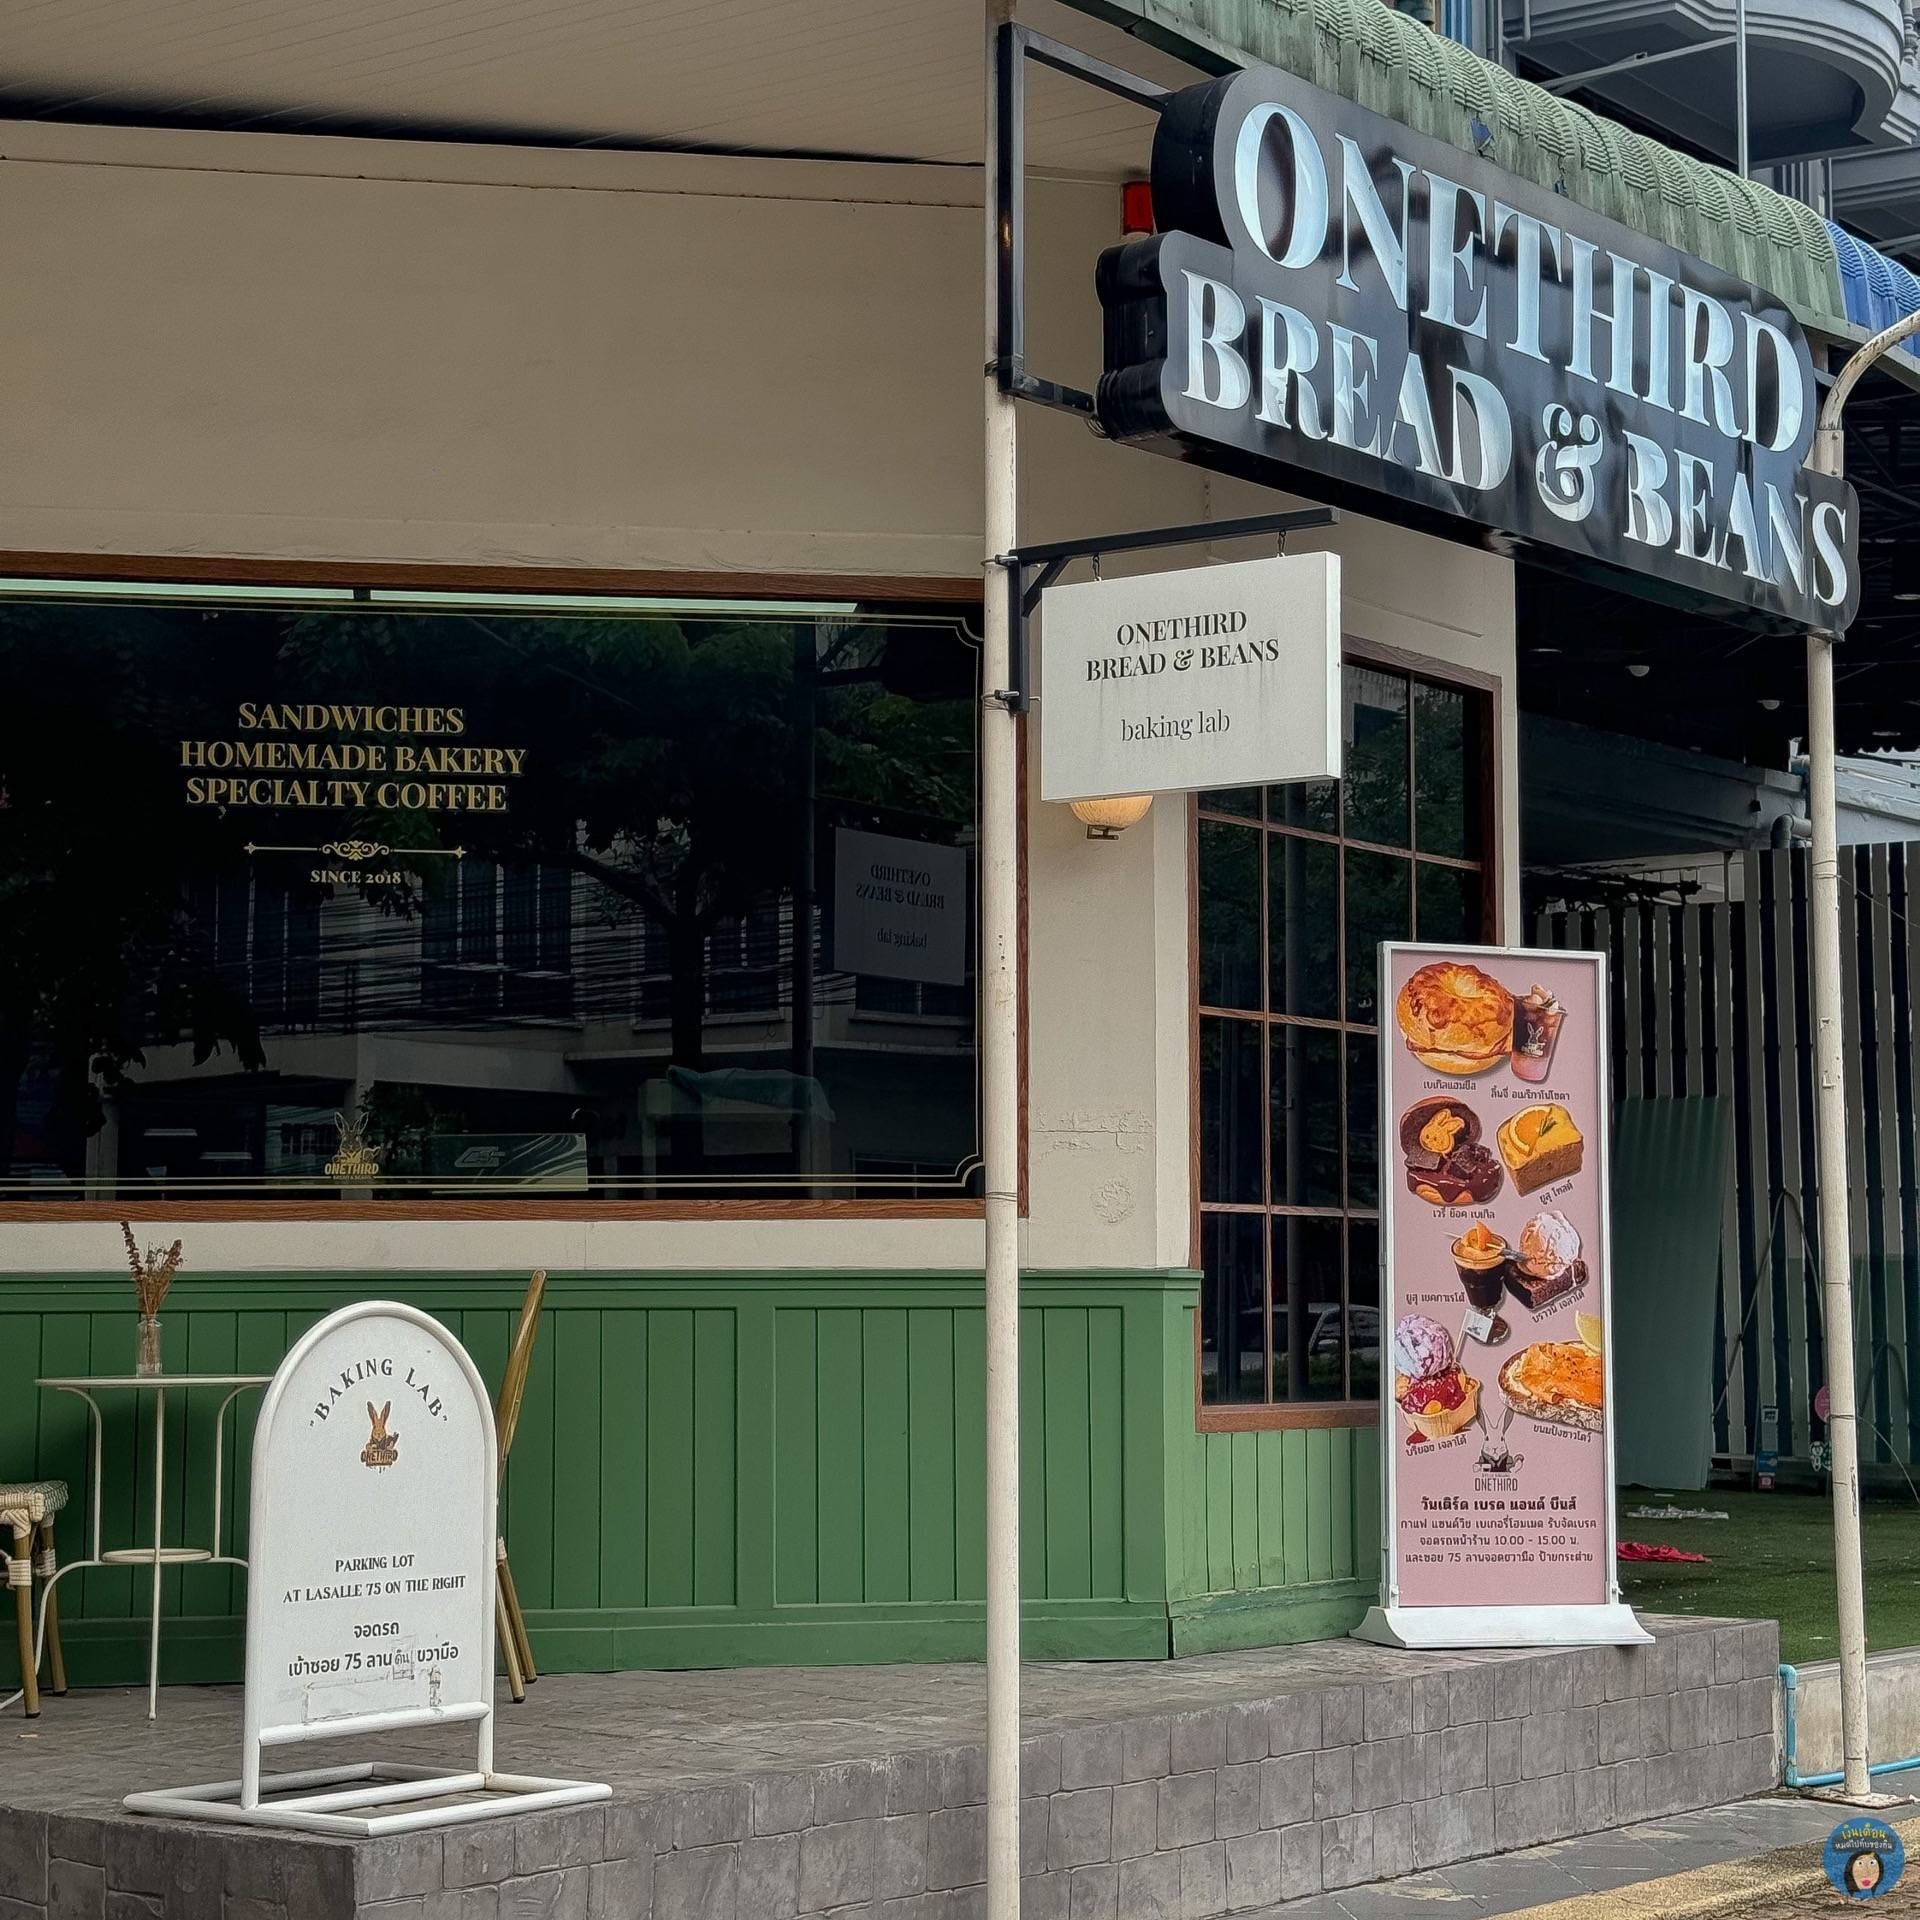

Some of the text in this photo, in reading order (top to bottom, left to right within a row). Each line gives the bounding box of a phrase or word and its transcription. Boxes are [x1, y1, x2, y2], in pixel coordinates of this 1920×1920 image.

[1234, 101, 1804, 452] ONETHIRD
[1180, 268, 1848, 606] BREAD & BEANS
[1116, 610, 1248, 646] ONETHIRD
[1086, 638, 1279, 681] BREAD & BEANS
[238, 702, 465, 733] SANDWICHES
[1121, 709, 1231, 742] baking lab
[180, 740, 526, 775] HOMEMADE BAKERY
[186, 777, 507, 810] SPECIALTY COFFEE
[310, 869, 401, 885] SINCE 2018
[324, 1163, 379, 1175] ONETHIRD
[1474, 1477, 1518, 1491] ONETHIRD
[1400, 1518, 1427, 1529] กาแฟ
[1494, 1536, 1524, 1545] 10.00
[1537, 1536, 1566, 1545] 15.00
[335, 1554, 415, 1572] PARKING LOT
[1448, 1552, 1461, 1562] 75
[283, 1575, 466, 1603] AT LASALLE 75 ON THE RIGHT
[354, 1621, 399, 1638] จอดรถ
[289, 1656, 340, 1676] เข้าซอย
[345, 1653, 361, 1670] 75
[417, 1641, 459, 1662] ขวามือ
